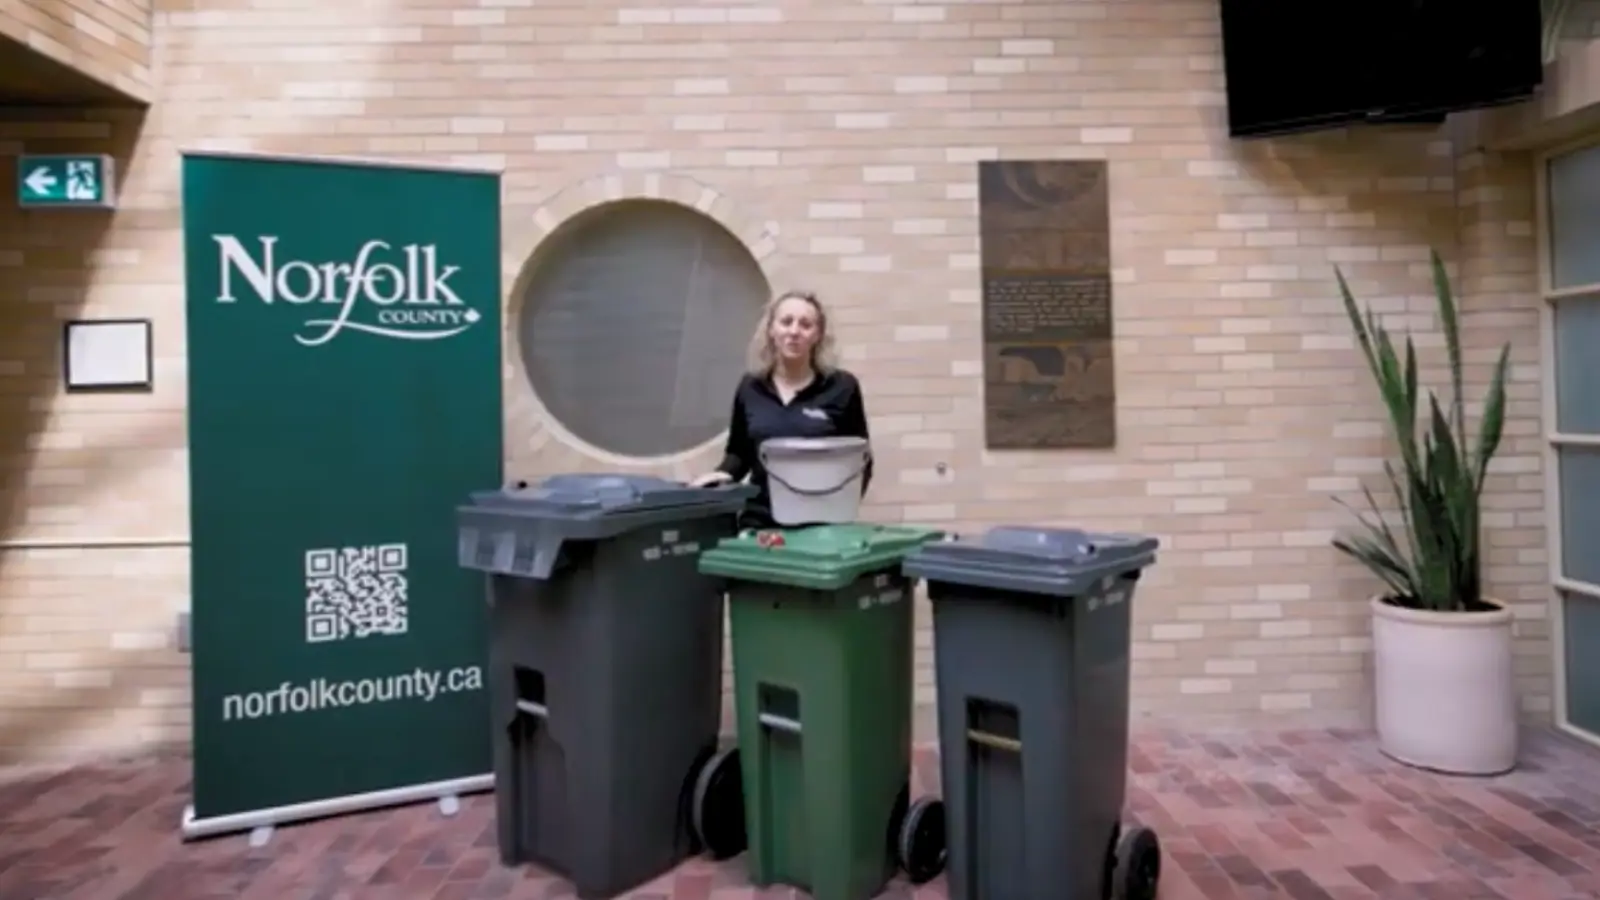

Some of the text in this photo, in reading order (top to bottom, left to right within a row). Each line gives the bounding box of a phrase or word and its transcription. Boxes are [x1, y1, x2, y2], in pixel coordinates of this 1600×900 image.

[212, 235, 464, 345] Norfolk
[378, 310, 463, 324] COUNTY
[223, 666, 483, 721] norfolkcounty.ca
